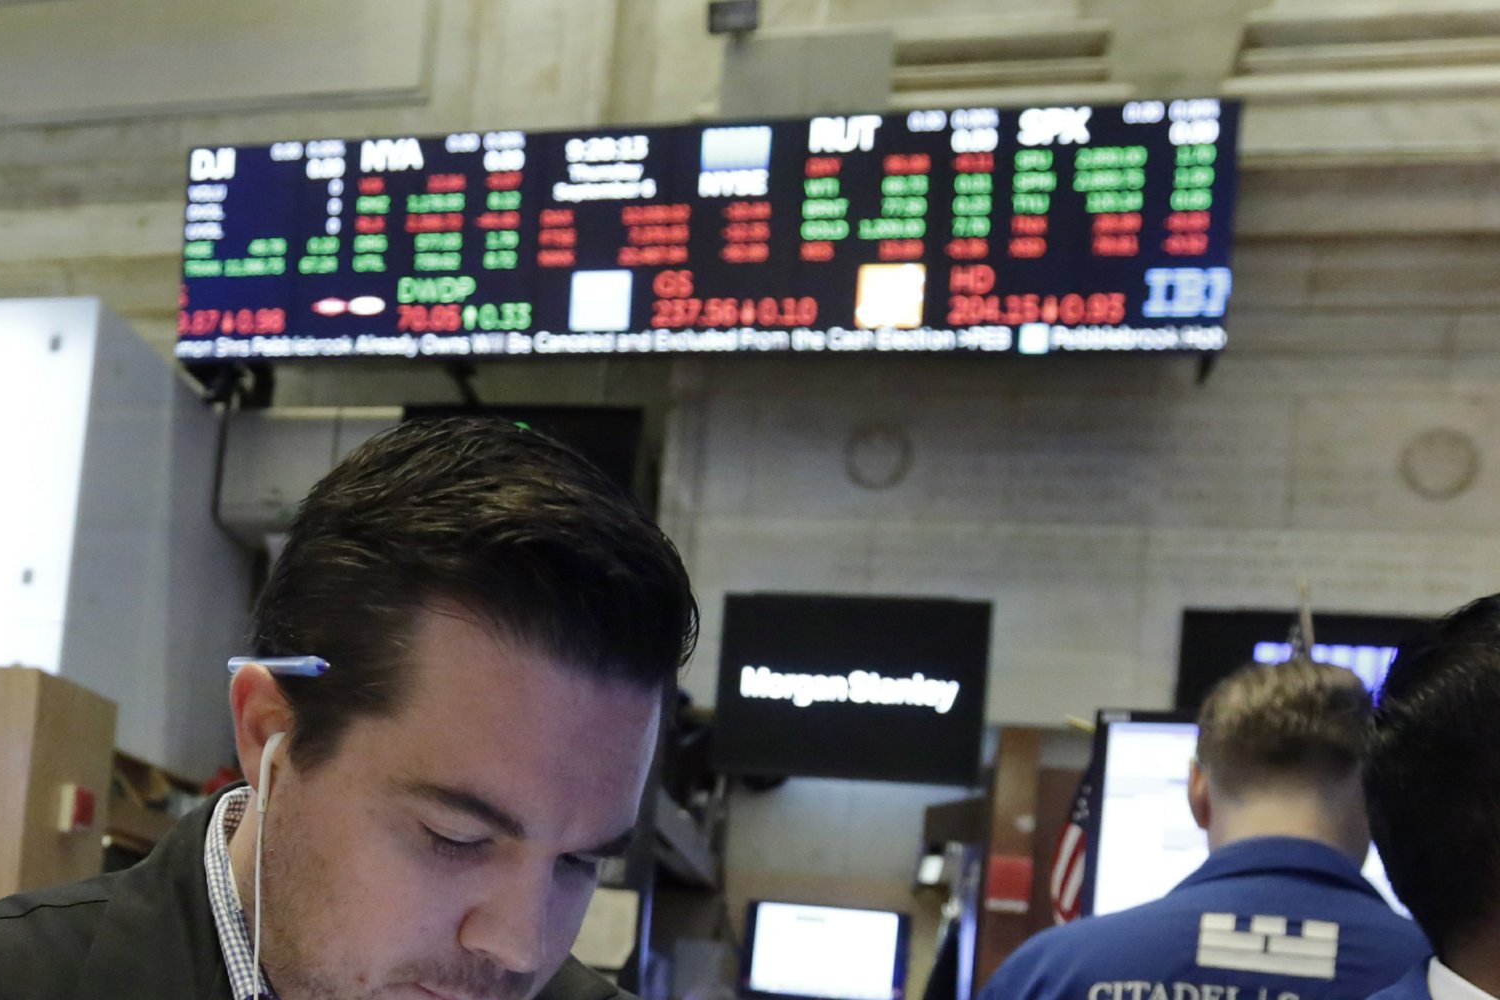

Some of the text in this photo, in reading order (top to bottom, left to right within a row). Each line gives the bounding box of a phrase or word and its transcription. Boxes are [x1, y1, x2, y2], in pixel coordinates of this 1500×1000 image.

[808, 114, 882, 153] RUT
[1017, 106, 1092, 146] SPX
[190, 147, 236, 181] DJI
[950, 264, 996, 295] HD
[740, 665, 960, 714] Morgan Stanley
